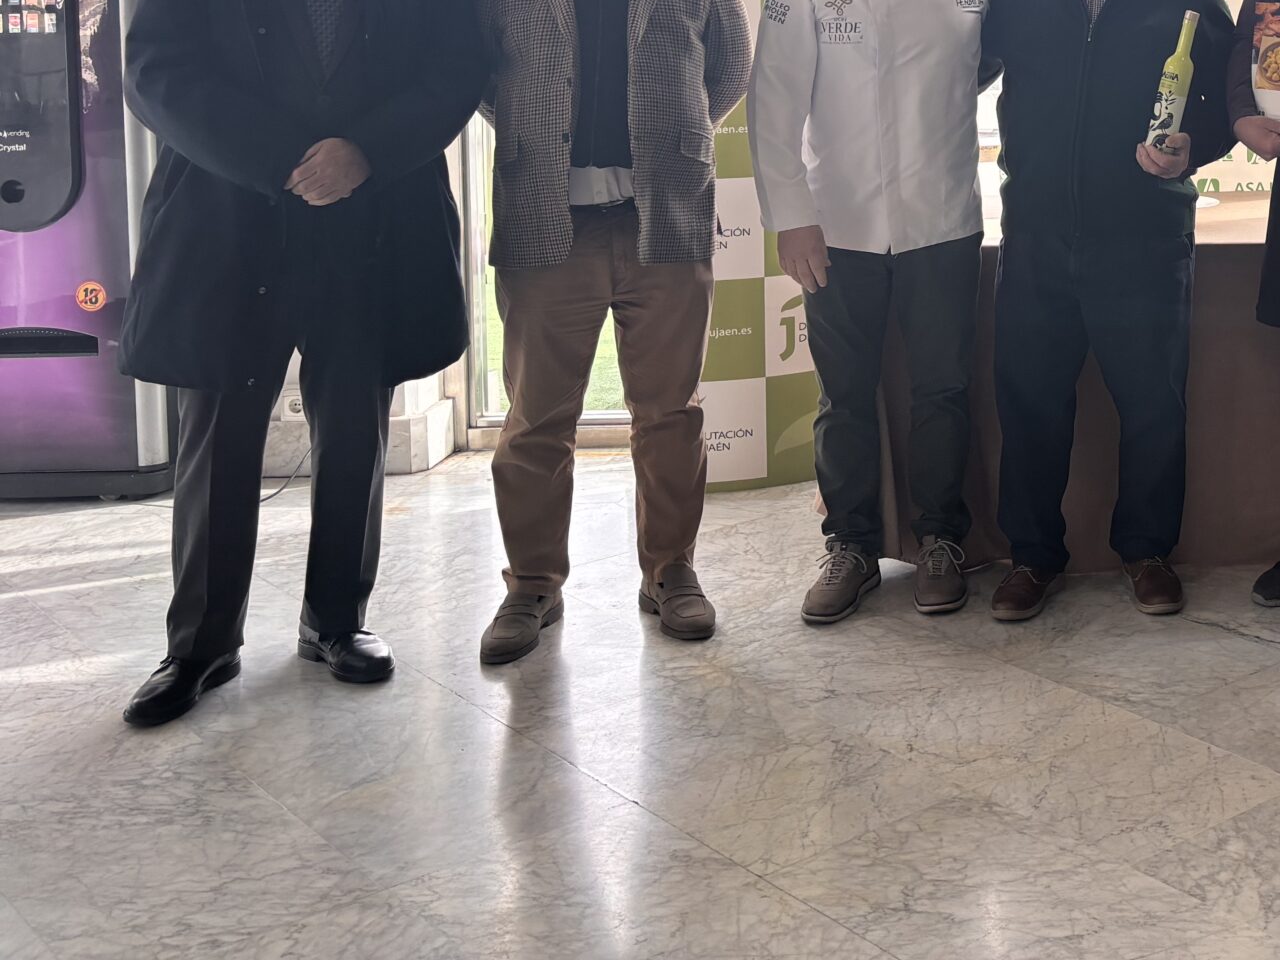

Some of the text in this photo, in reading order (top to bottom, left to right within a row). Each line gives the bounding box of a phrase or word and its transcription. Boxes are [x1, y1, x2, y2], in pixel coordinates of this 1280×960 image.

[770, 0, 791, 12] OLEO
[767, 13, 786, 25] AEN
[821, 21, 862, 34] VERDE
[828, 33, 851, 42] VIDA
[709, 326, 752, 340] ujaen.es
[705, 428, 754, 441] UTACIÓN
